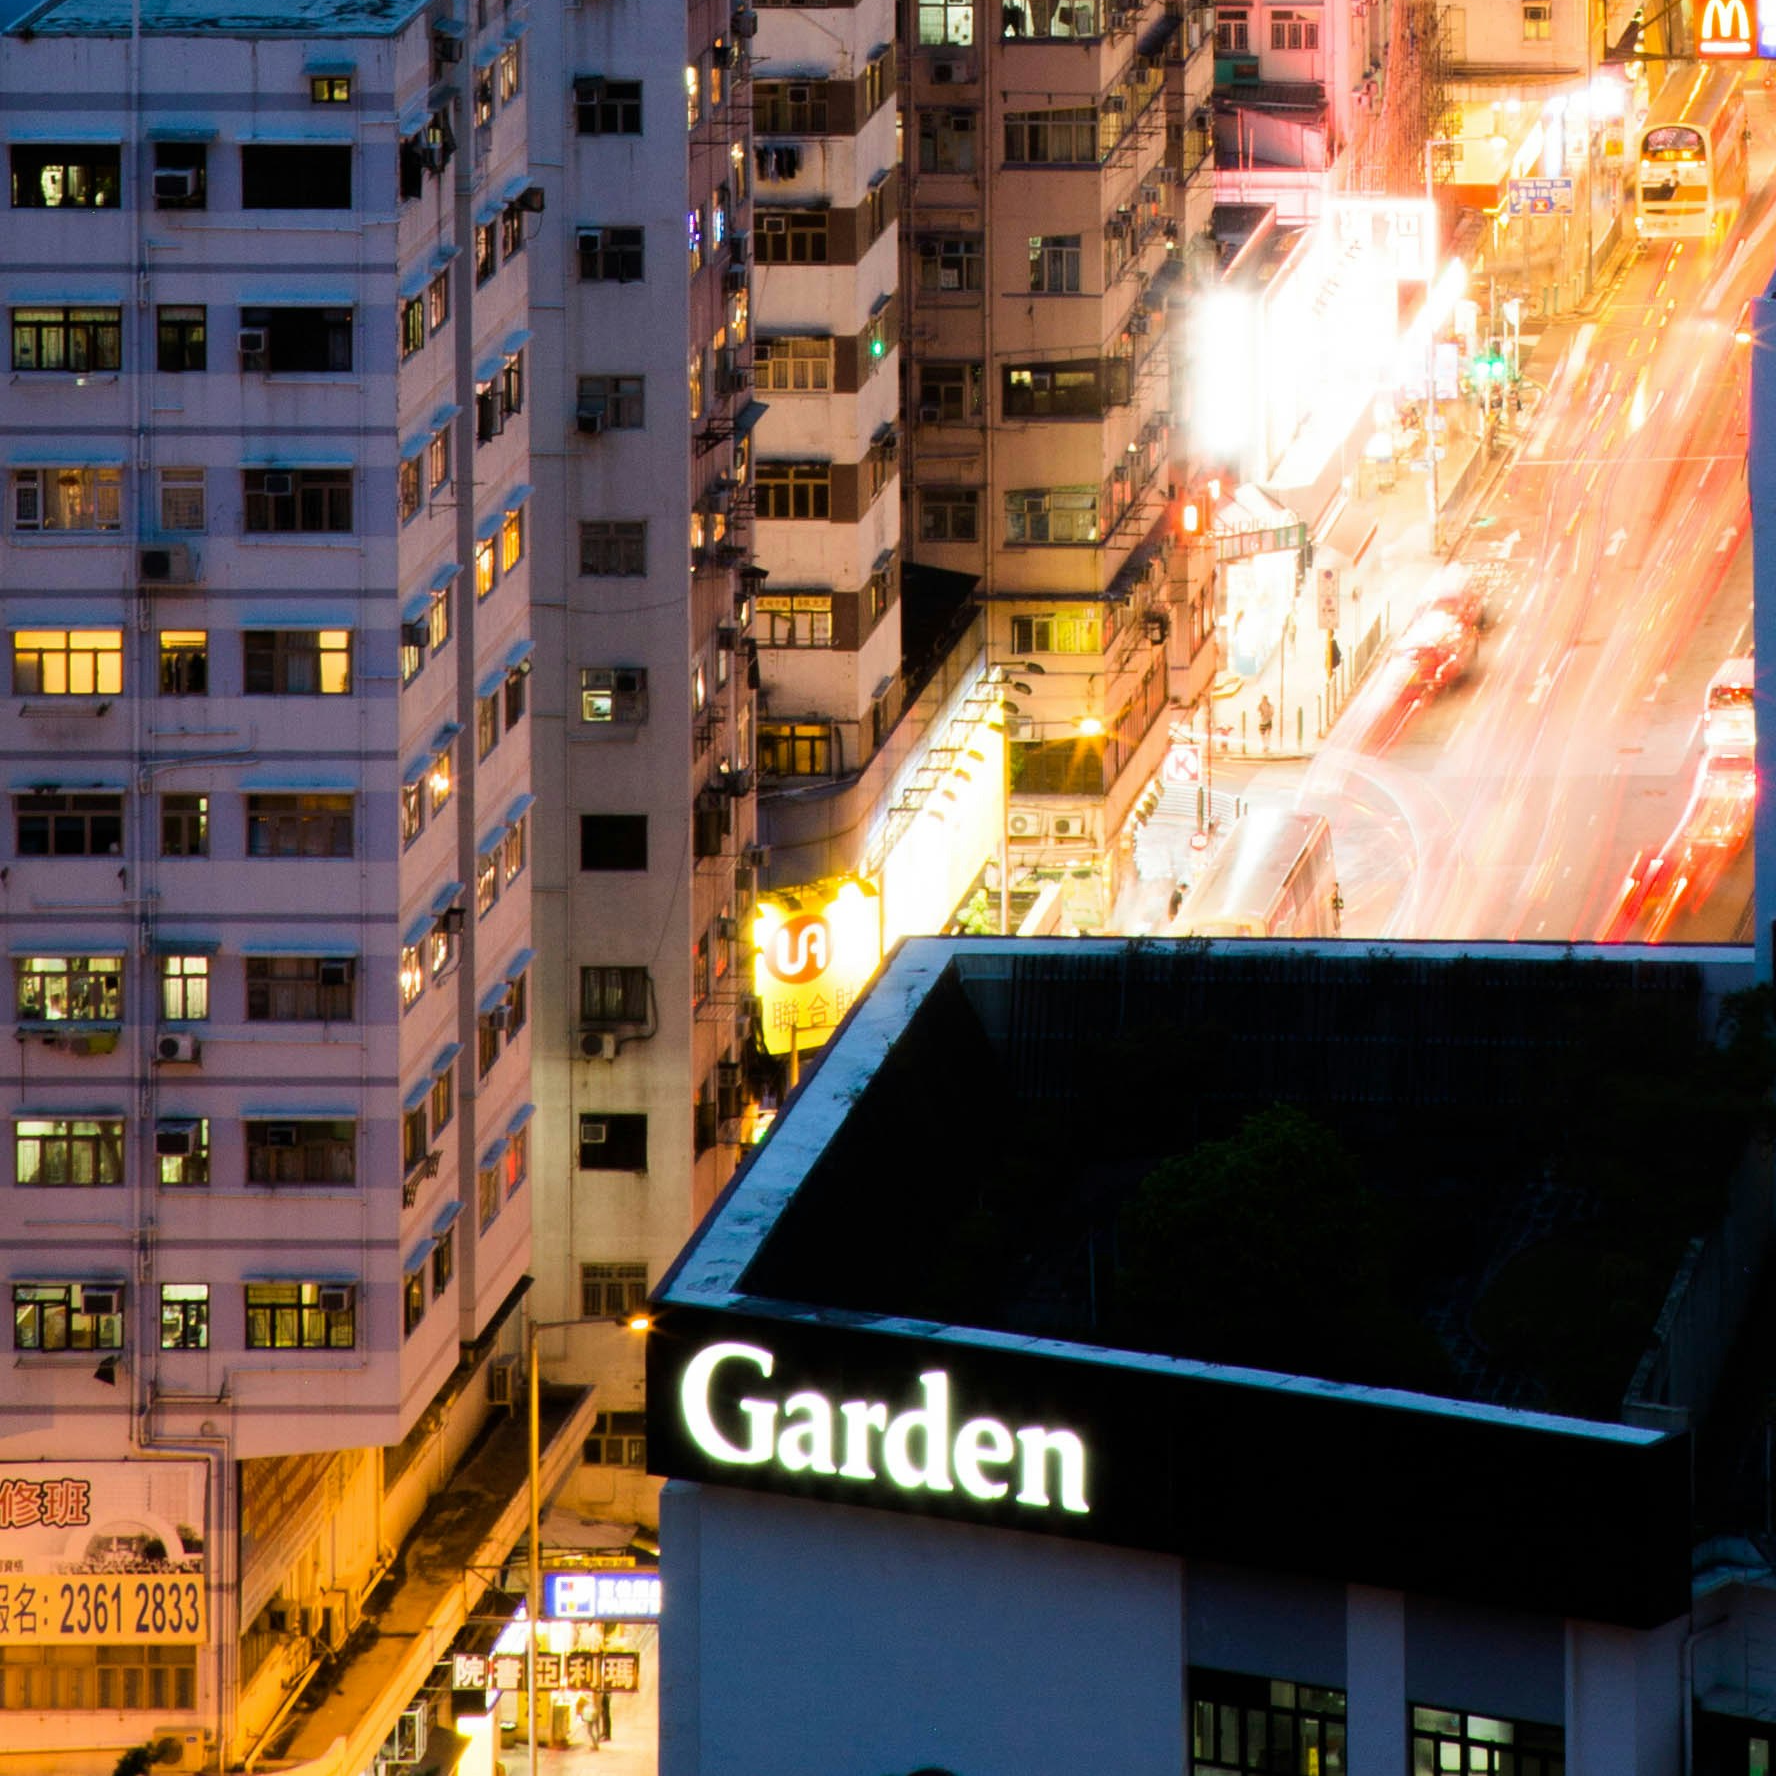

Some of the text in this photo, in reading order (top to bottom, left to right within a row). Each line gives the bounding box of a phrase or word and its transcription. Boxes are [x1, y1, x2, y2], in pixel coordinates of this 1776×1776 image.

[680, 1341, 1090, 1513] Garden
[60, 1582, 122, 1634] 2361
[135, 1582, 199, 1634] 2833
